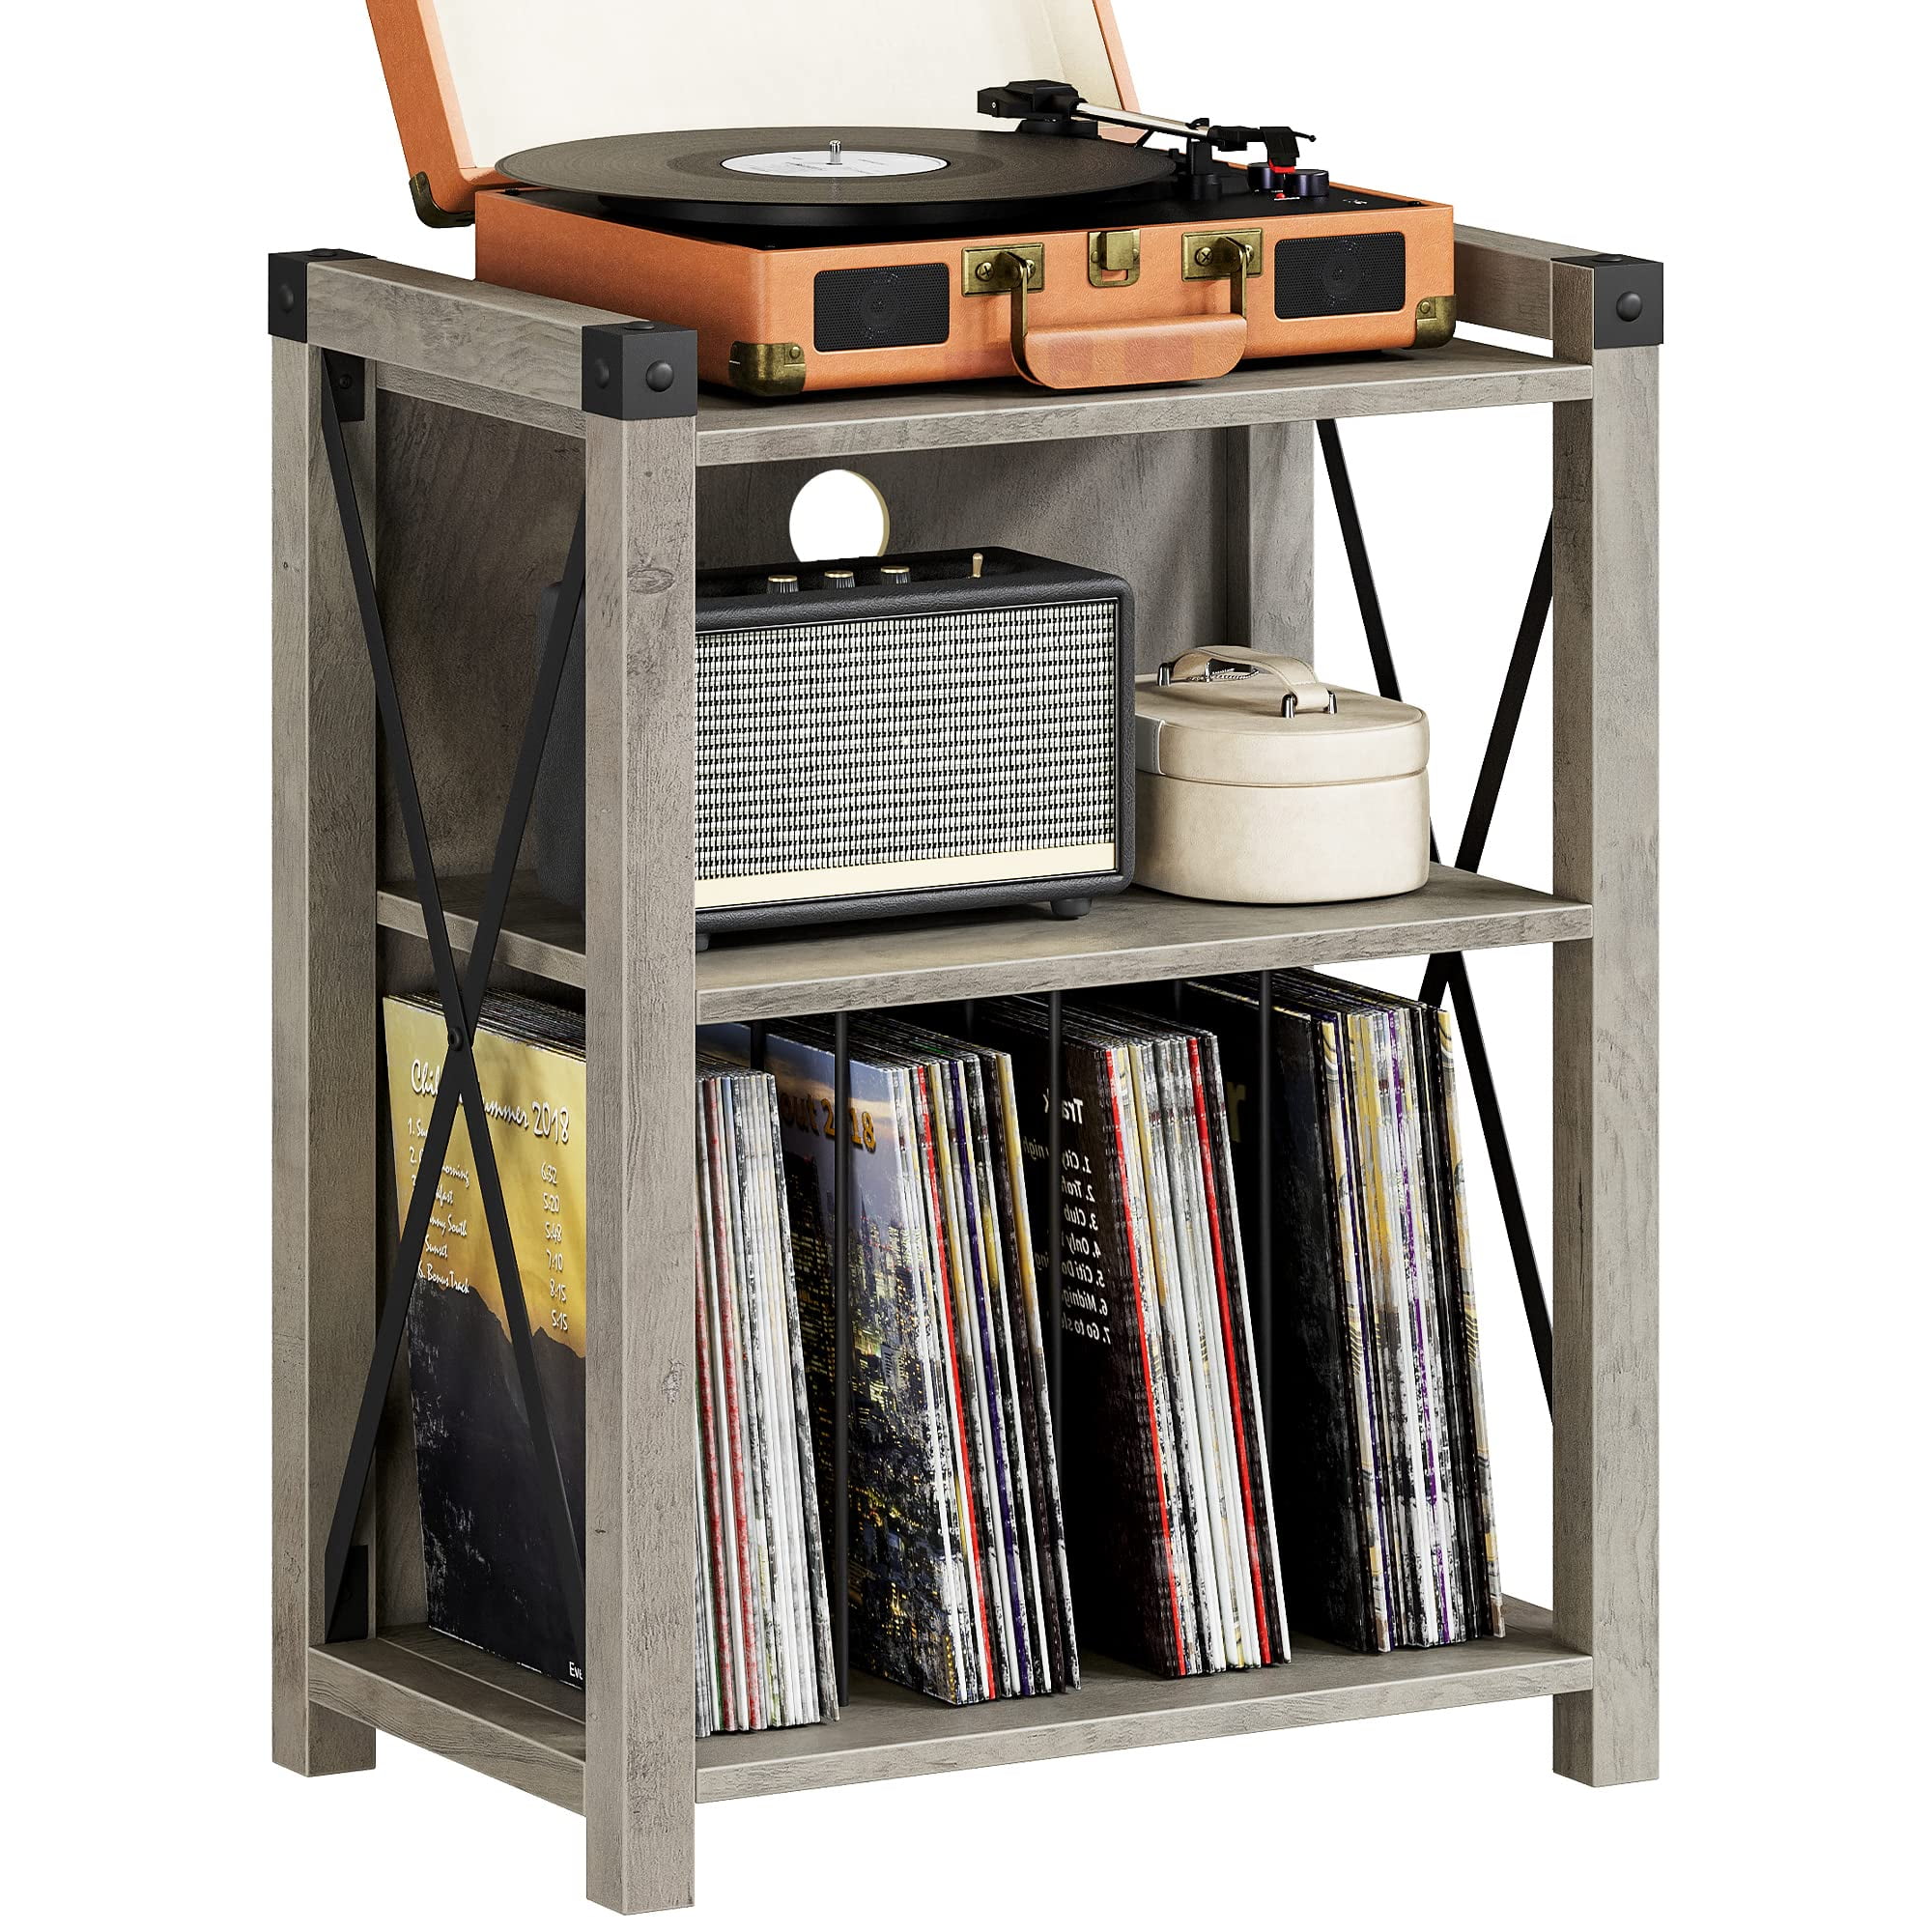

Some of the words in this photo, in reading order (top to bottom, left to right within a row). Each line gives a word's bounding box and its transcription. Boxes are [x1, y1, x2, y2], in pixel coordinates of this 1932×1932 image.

[411, 1059, 441, 1095] Chil
[483, 1096, 529, 1129] ummer
[531, 1101, 569, 1143] 2018
[408, 1117, 415, 1136] 1.
[821, 1097, 876, 1152] 218
[447, 1214, 467, 1236] South
[425, 1235, 448, 1259] Sunset
[546, 1248, 563, 1271] 7:10
[427, 1264, 448, 1287] Bonus
[449, 1270, 469, 1294] Track
[550, 1278, 566, 1301] 8:15
[551, 1309, 568, 1330] 5:15
